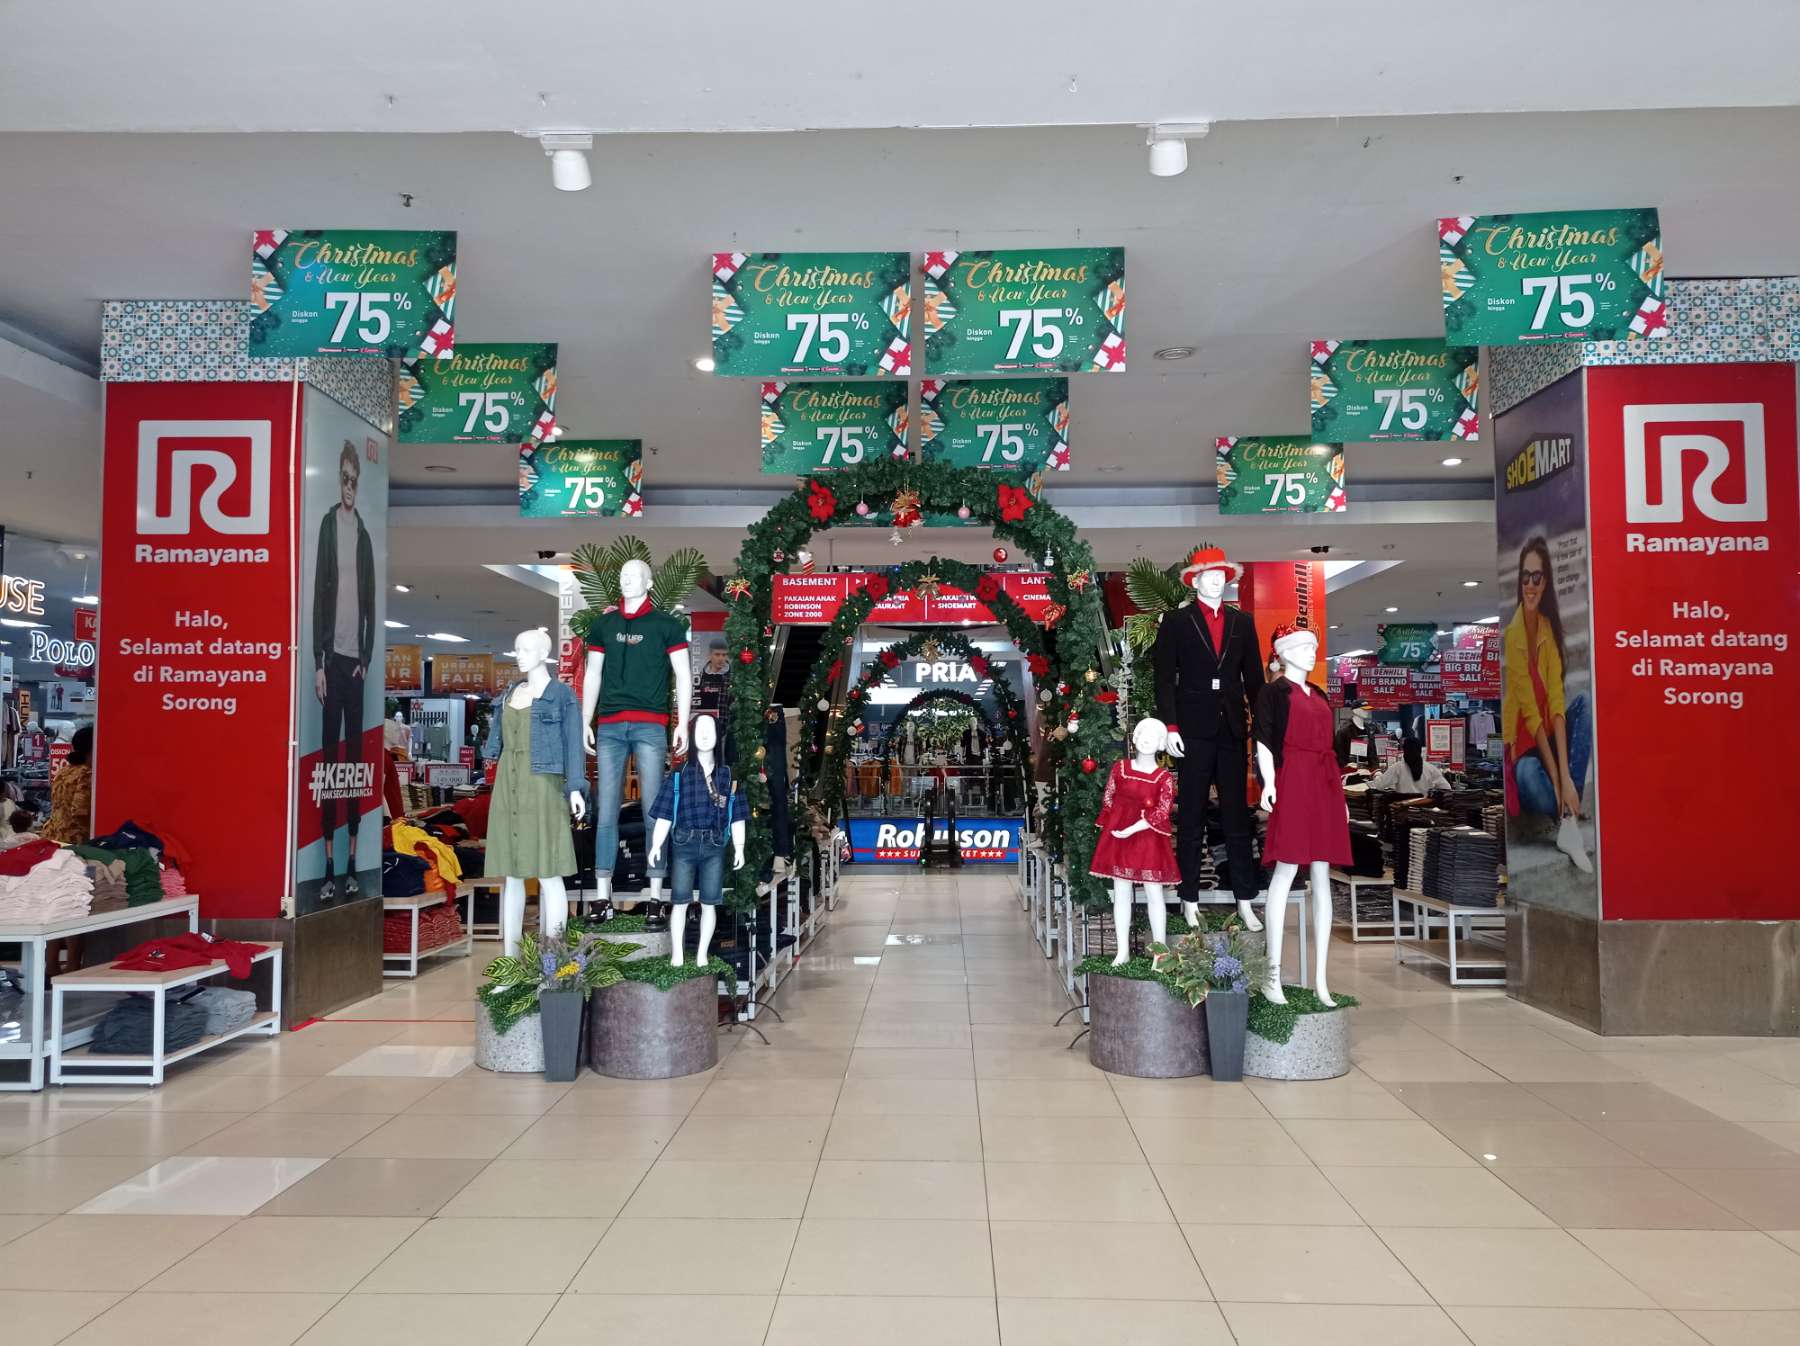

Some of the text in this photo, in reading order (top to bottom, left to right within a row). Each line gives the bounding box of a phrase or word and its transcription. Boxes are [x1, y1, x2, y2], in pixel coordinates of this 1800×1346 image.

[1475, 224, 1618, 256] Christmas
[288, 241, 418, 269] Christmas
[1509, 250, 1549, 271] New
[1551, 248, 1598, 273] Year
[317, 266, 352, 284] New
[354, 265, 399, 289] Year
[746, 265, 874, 292] Christmas
[959, 260, 1088, 289] Christmas
[777, 288, 811, 307] New
[813, 287, 855, 310] Year
[989, 283, 1025, 304] New
[1026, 282, 1068, 306] Year
[1522, 272, 1616, 330] 75%
[325, 292, 412, 344] 75%
[786, 312, 870, 363] 75%
[966, 328, 992, 336] Diskon
[999, 308, 1083, 360] 75%
[434, 353, 529, 375] Christmas
[1339, 349, 1448, 372] Christmas
[452, 372, 478, 387] New
[480, 372, 513, 390] Year
[1365, 368, 1393, 384] New
[1395, 367, 1432, 386] Year
[787, 388, 881, 411] Christmas
[946, 387, 1041, 409] Christmas
[458, 391, 525, 433] 75%
[808, 409, 834, 423] New
[835, 407, 867, 425] Year
[968, 406, 993, 420] New
[996, 405, 1027, 422] Year
[1374, 388, 1444, 431] 75%
[817, 425, 879, 464] 75%
[977, 423, 1039, 462] 75%
[1239, 442, 1320, 461] Christma
[583, 462, 608, 475] Year
[1283, 459, 1308, 472] Year
[1506, 438, 1571, 490] SHOEMART
[564, 477, 617, 509] 75%
[1264, 472, 1318, 506] 75%
[135, 544, 269, 566] Ramayana
[1626, 533, 1769, 555] Ramayana
[782, 578, 837, 586] BASEMENT
[1295, 563, 1308, 629] Benhill
[175, 610, 228, 630] Halo,
[1673, 601, 1730, 620] Halo,
[119, 638, 282, 660] Selamat datang
[1615, 629, 1788, 651] Selamat datang
[133, 665, 267, 687] di Ramayana
[441, 674, 485, 682] FAIR
[915, 662, 977, 683] PRIA
[1445, 664, 1461, 672] BIG
[1632, 658, 1774, 680] di Ramayana
[162, 693, 237, 715] Sorong
[1664, 688, 1744, 709] Sorong
[309, 763, 375, 808] #KEREN
[876, 823, 1010, 848] Robson
